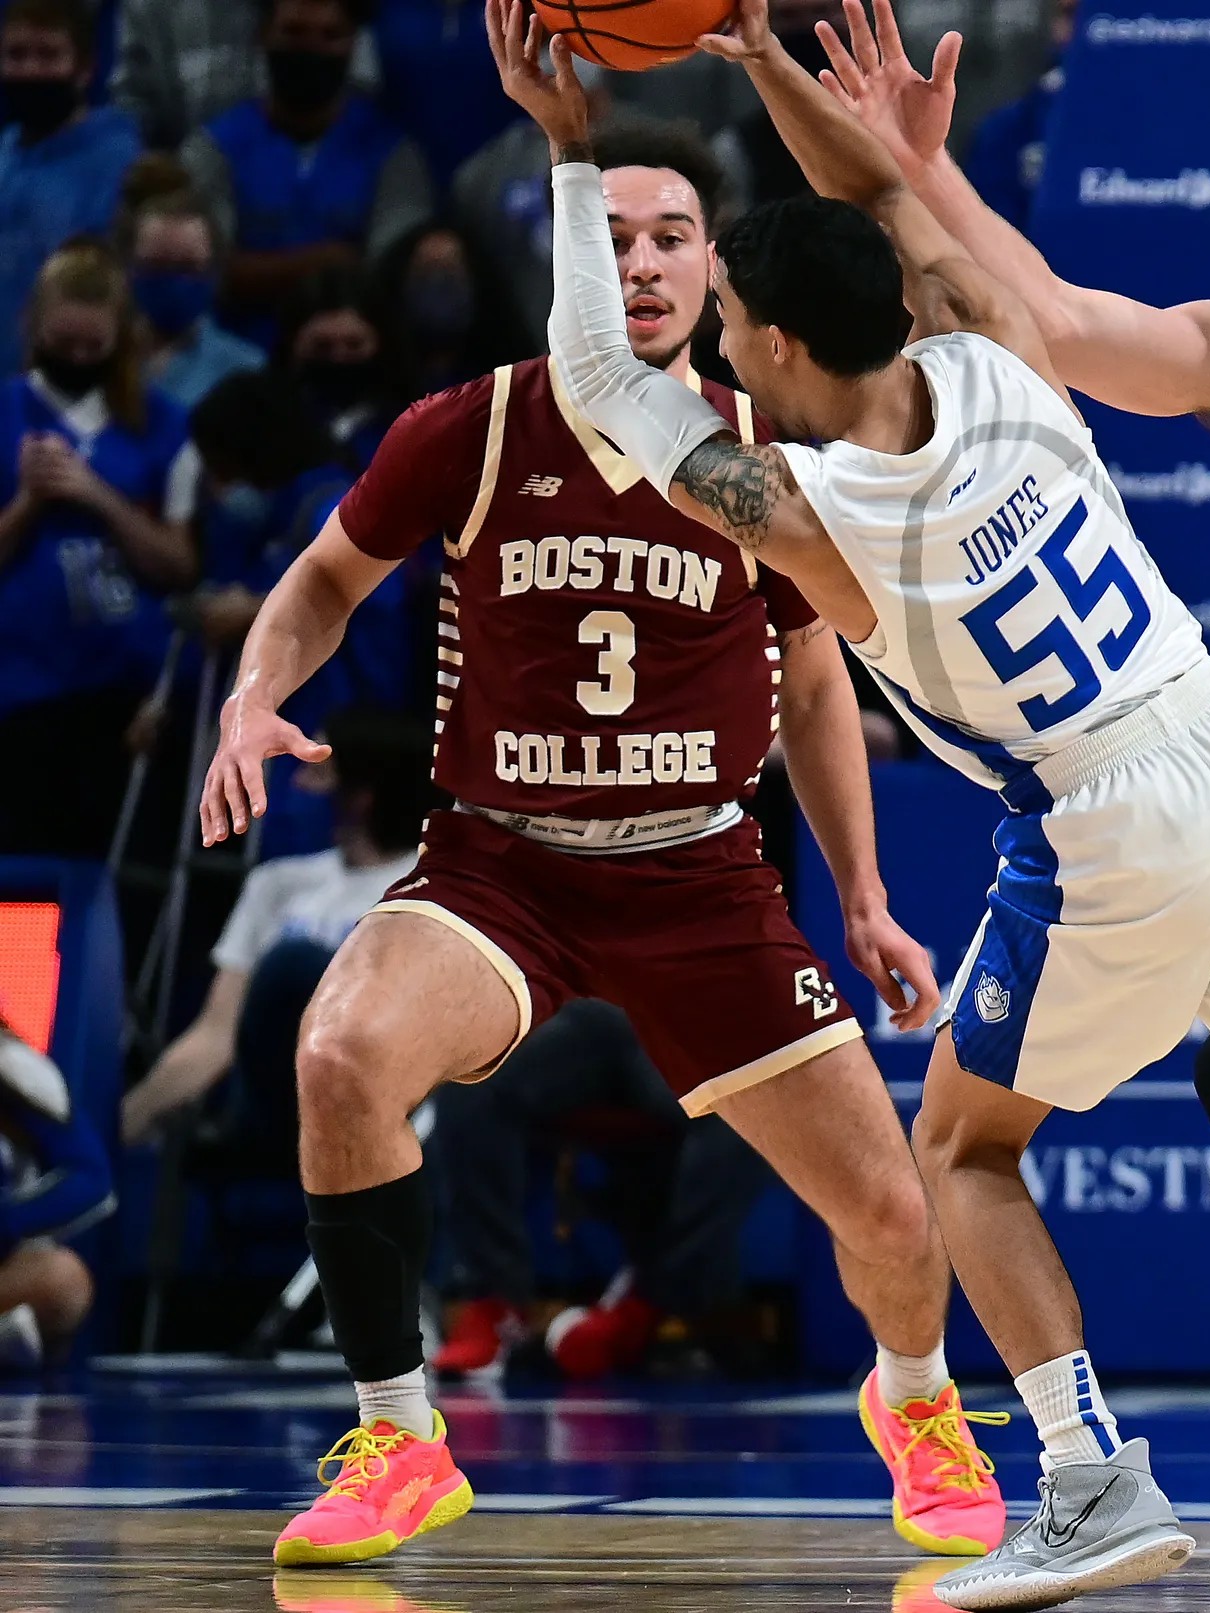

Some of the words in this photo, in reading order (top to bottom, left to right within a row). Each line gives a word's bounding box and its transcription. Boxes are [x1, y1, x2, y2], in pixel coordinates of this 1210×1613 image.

[500, 536, 721, 612] BOSTON
[958, 474, 1049, 585] JONES
[576, 610, 636, 716] 3
[958, 494, 1151, 733] 55
[494, 730, 717, 785] COLLEGE
